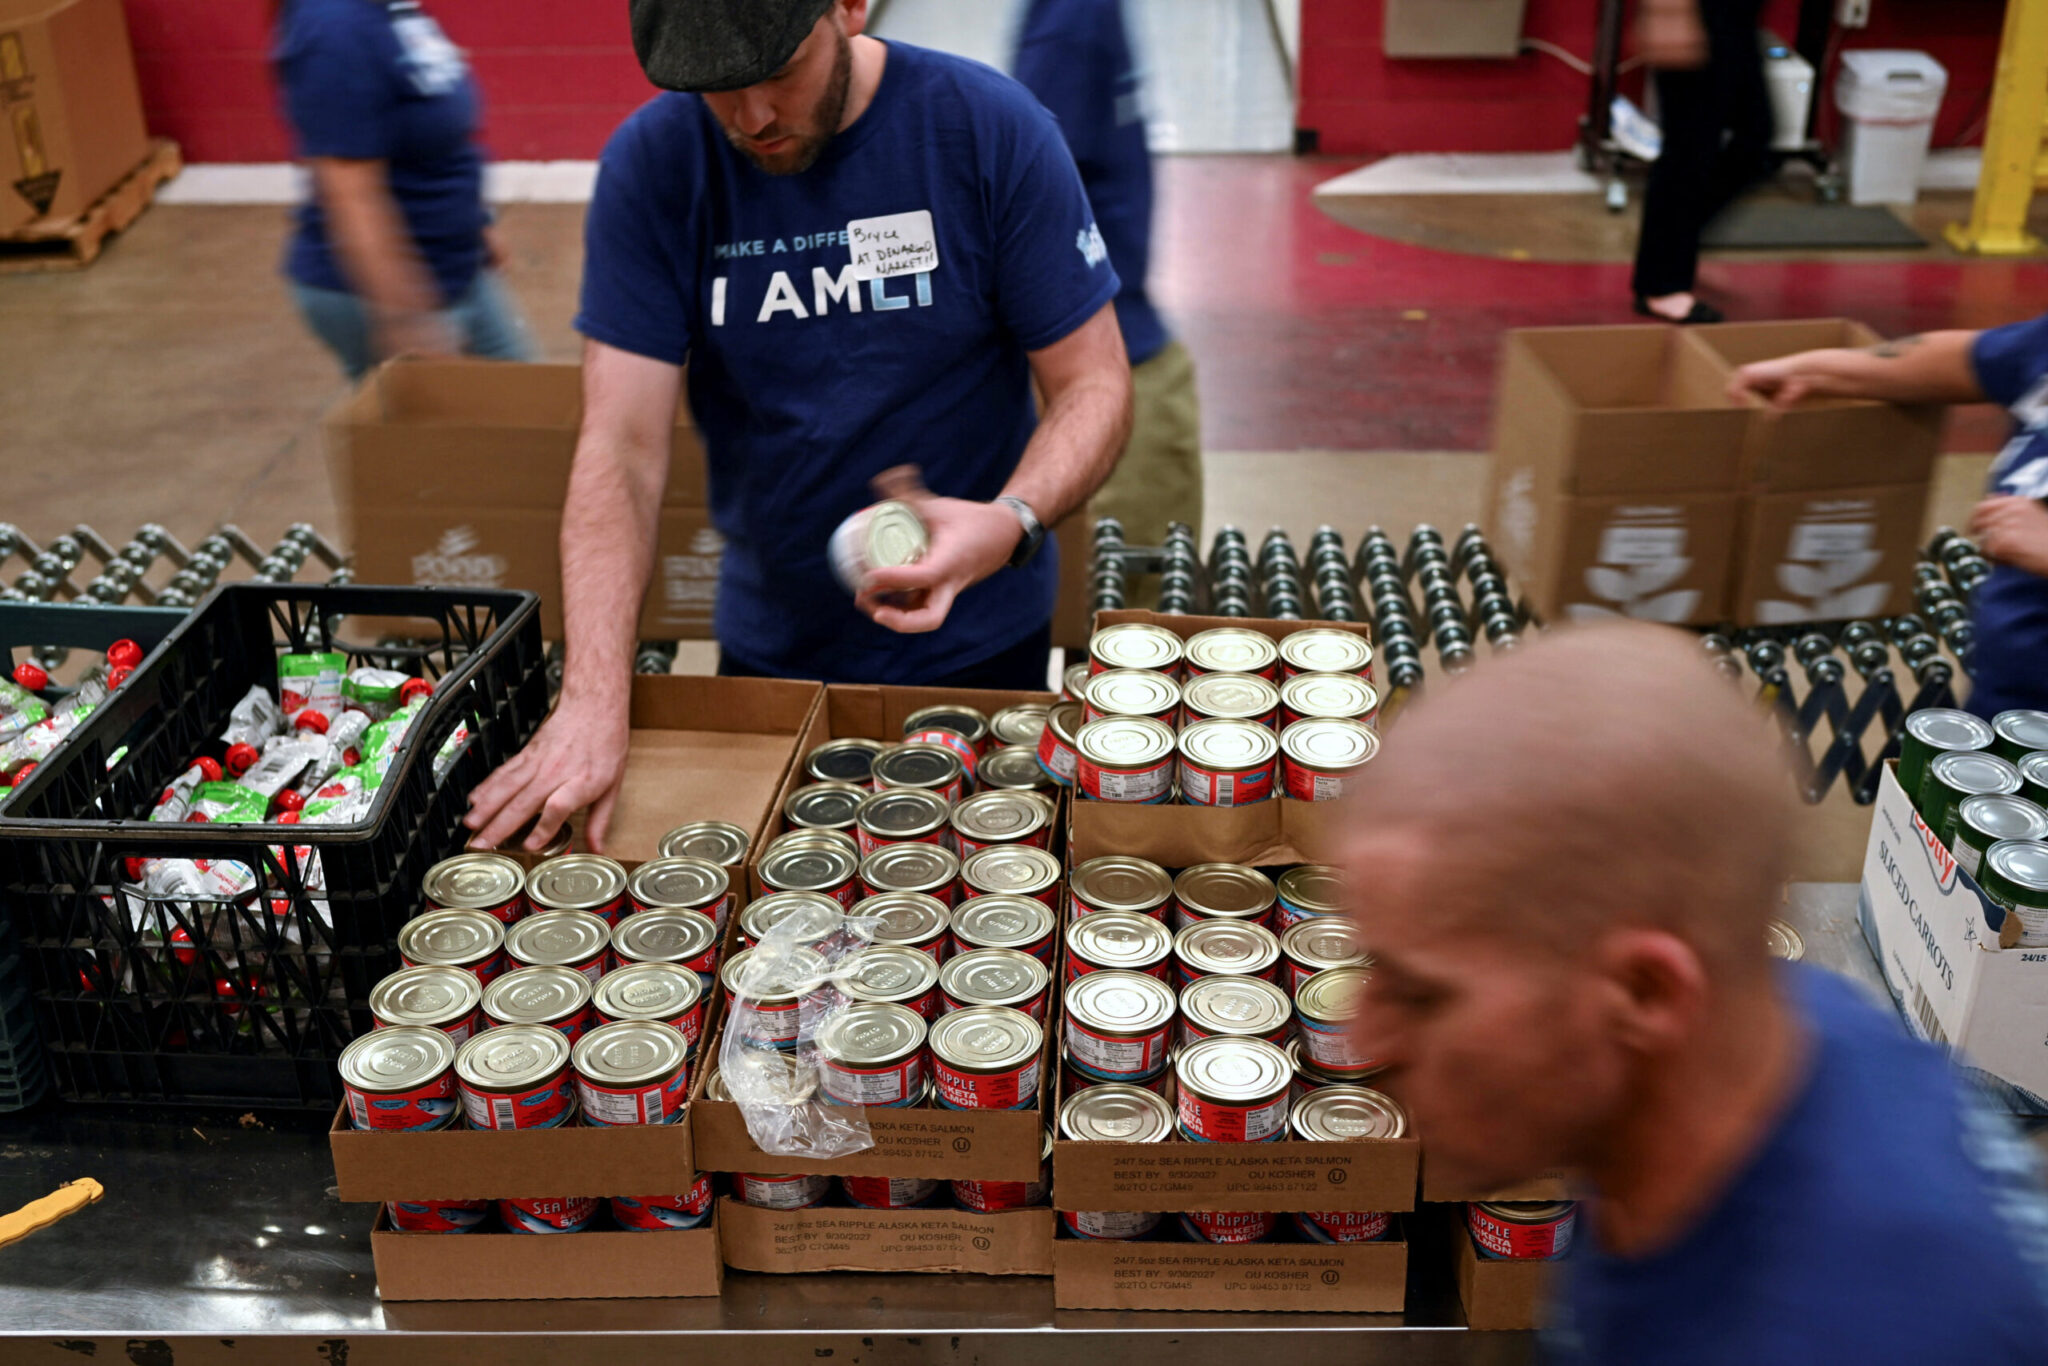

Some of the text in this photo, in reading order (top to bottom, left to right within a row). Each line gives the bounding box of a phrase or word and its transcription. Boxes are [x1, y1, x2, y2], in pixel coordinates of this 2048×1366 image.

[853, 227, 899, 243] Bryce
[714, 230, 849, 259] MAKE A DIFFE
[858, 252, 871, 265] AT
[711, 277, 728, 326] I
[1879, 839, 1911, 906] SLICED
[1909, 899, 1954, 991] CARROTS
[936, 1064, 976, 1092] RIPPLE
[947, 1086, 978, 1100] KETA
[900, 1123, 928, 1132] KETA
[930, 1123, 975, 1134] SALMON
[896, 1136, 941, 1146] KOSHER
[1159, 1157, 1181, 1166] SEA
[1183, 1157, 1223, 1166] RIPPLE
[1226, 1157, 1270, 1166] ALASKA
[1272, 1156, 1302, 1165] KETA
[1305, 1156, 1352, 1165] SALMON
[1113, 1171, 1144, 1179] BEST
[1146, 1171, 1160, 1179] BY
[1269, 1170, 1316, 1179] KOSHER
[1226, 1183, 1250, 1192] UPC
[674, 1189, 699, 1208] SEA
[532, 1201, 561, 1215] SEA
[1216, 1212, 1264, 1227] RIPPLE
[816, 1220, 836, 1228] SEA
[839, 1220, 876, 1229] RIPPLE
[878, 1221, 918, 1229] ALASKA
[921, 1221, 949, 1229] KETA
[951, 1221, 994, 1234] SALMON
[1233, 1222, 1264, 1235] KETA
[774, 1233, 801, 1243] BEST
[804, 1232, 817, 1240] BY
[919, 1233, 962, 1242] KOSHER
[1209, 1228, 1264, 1242] SALMON
[1158, 1256, 1180, 1265] SEA
[1183, 1257, 1221, 1266] RIPPLE
[1223, 1257, 1265, 1266] ALASKA
[1268, 1258, 1297, 1266] KETA
[1299, 1258, 1345, 1267] SALMON
[1114, 1269, 1144, 1278] BEST
[1146, 1269, 1160, 1278] BY
[1264, 1271, 1309, 1279] KOSHER
[1225, 1282, 1247, 1290] UPC
